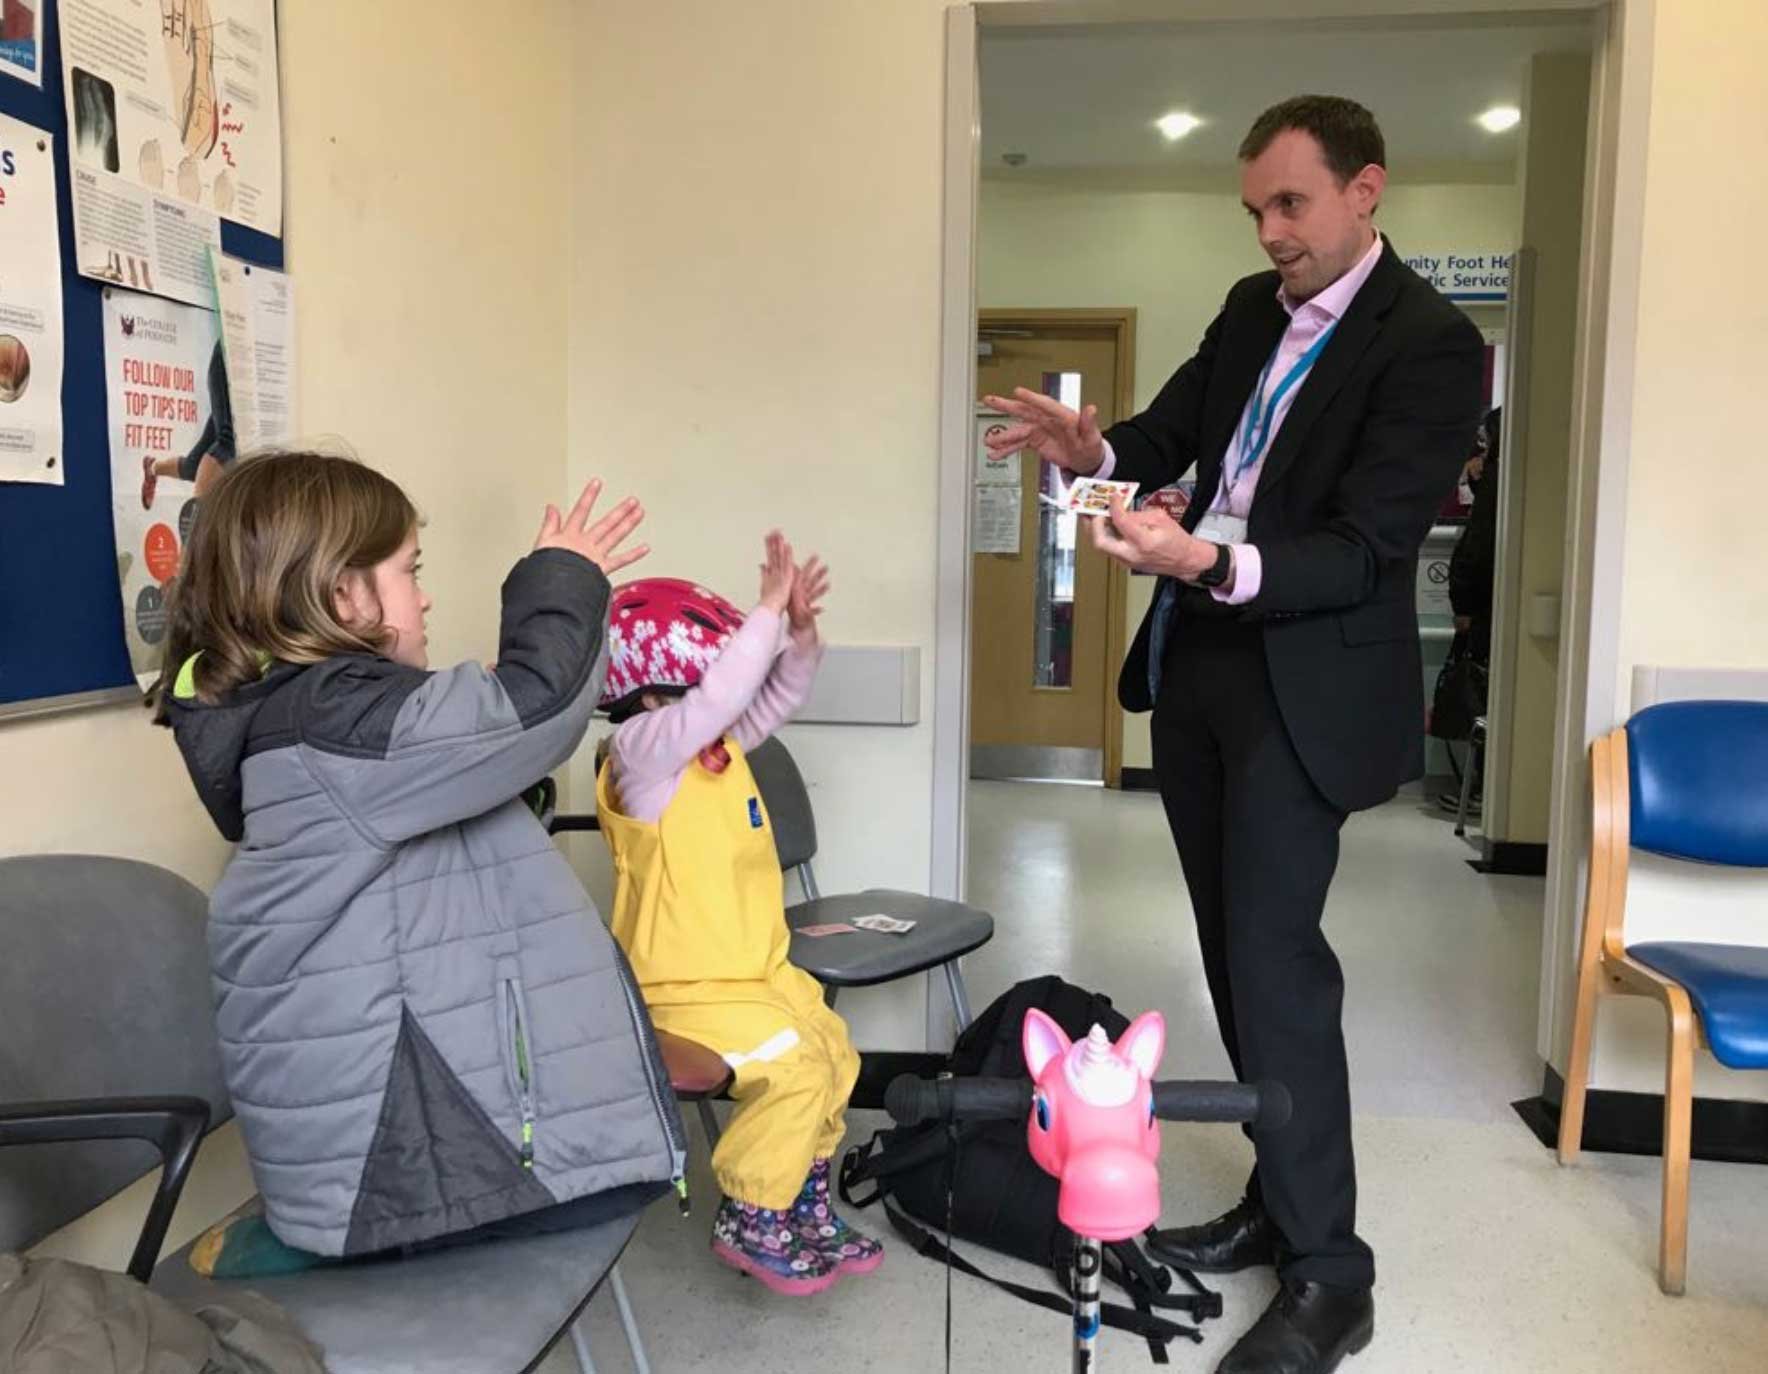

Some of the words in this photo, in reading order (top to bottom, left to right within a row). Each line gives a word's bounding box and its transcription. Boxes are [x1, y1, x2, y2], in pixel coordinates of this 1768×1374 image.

[1448, 255, 1484, 269] Foot
[123, 359, 171, 389] FOLLOW
[173, 367, 195, 393] OUR
[124, 391, 149, 416] TOP
[151, 395, 175, 420] TIPS
[178, 399, 198, 424] FOR
[125, 424, 143, 448] FIT
[145, 426, 173, 450] FEET
[157, 536, 164, 548] 2
[148, 597, 153, 609] 1
